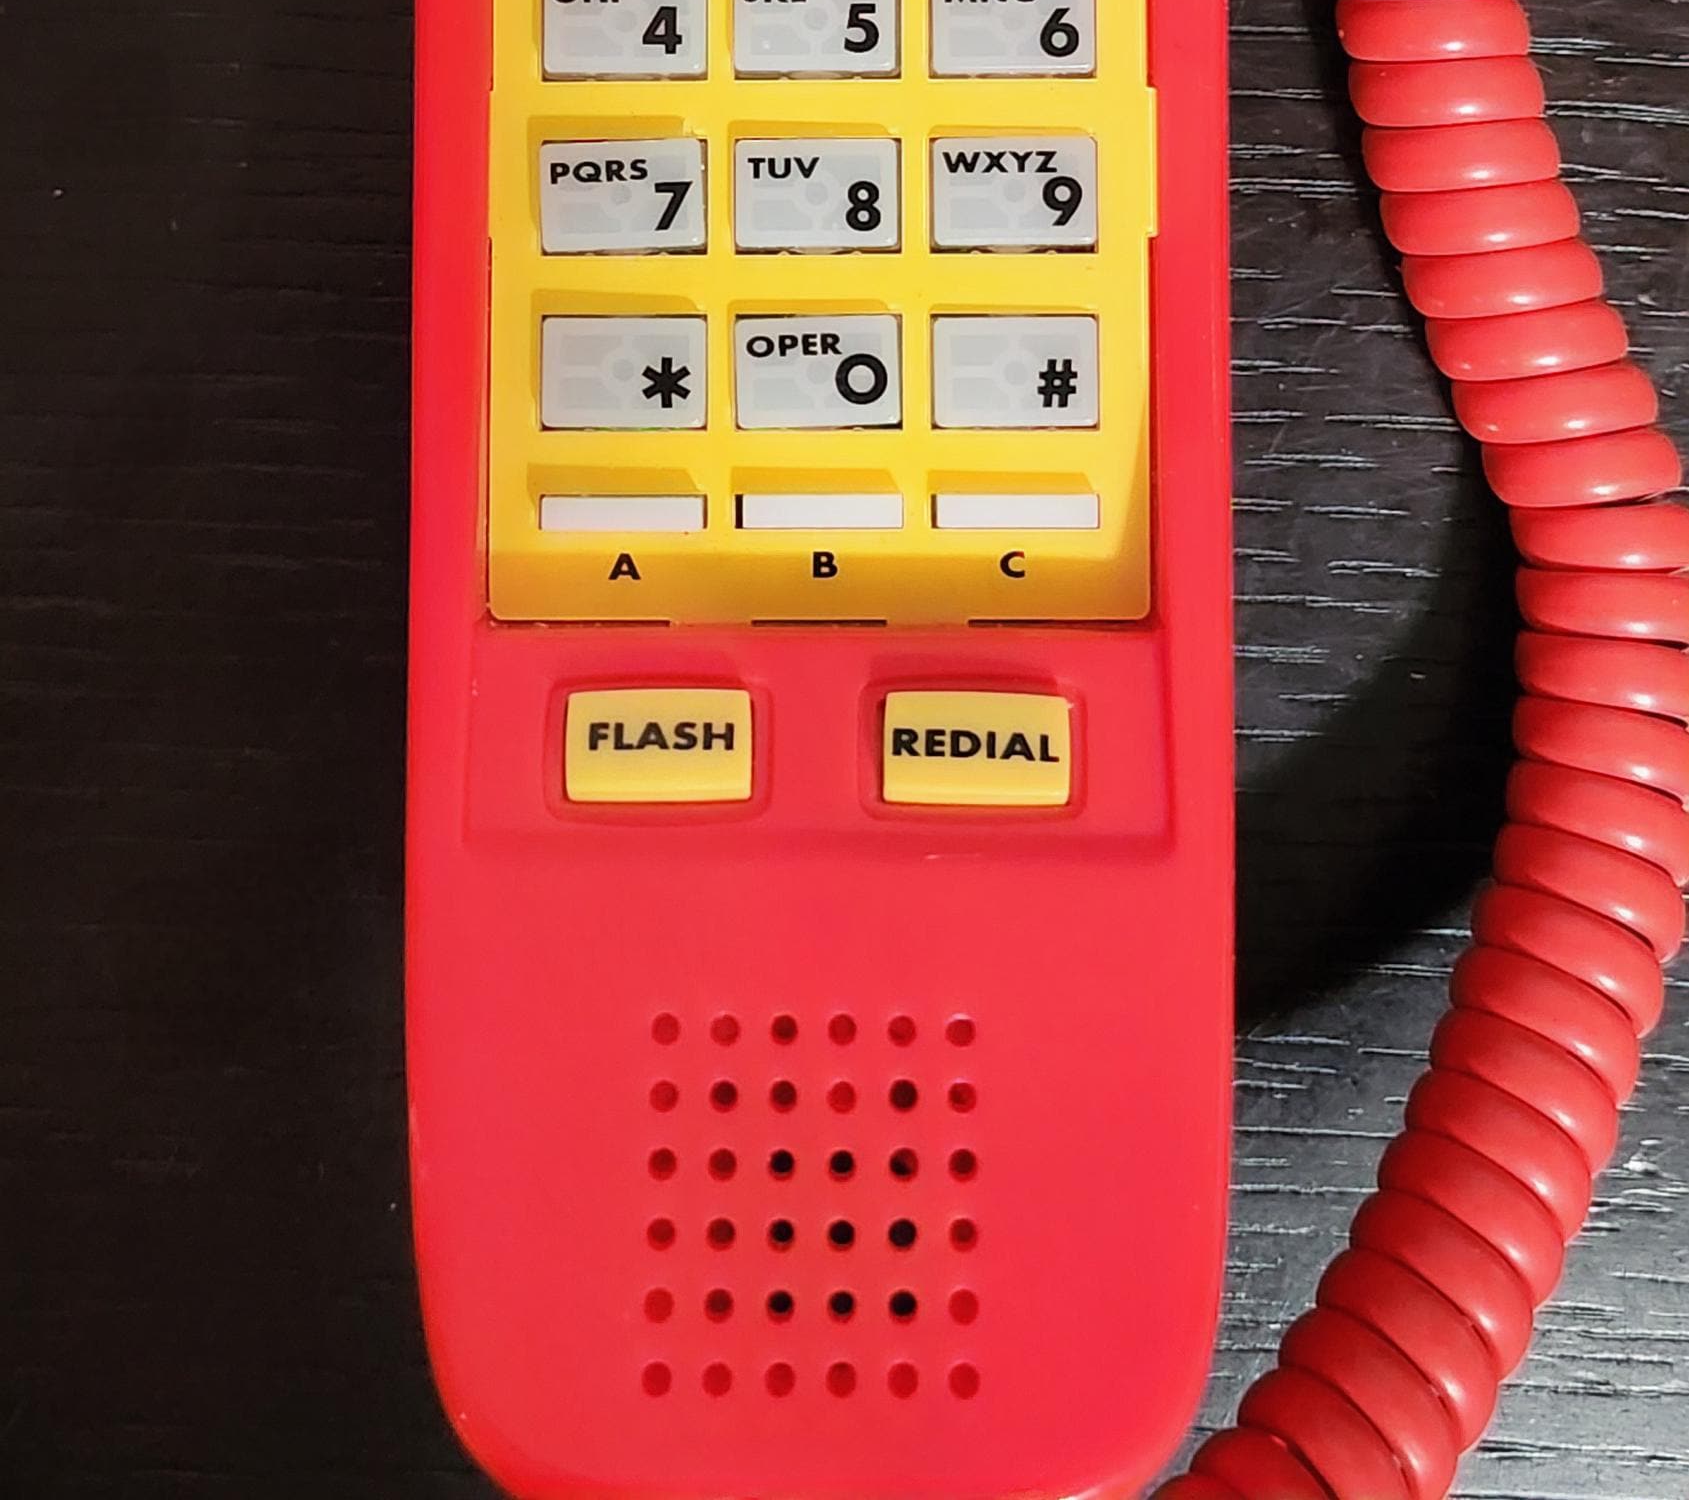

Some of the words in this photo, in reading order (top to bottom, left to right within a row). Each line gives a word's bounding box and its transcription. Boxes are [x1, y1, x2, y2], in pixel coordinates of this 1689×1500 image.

[642, 5, 683, 55] 4
[843, 2, 880, 54] 5
[1039, 7, 1080, 58] 6
[550, 158, 648, 185] PQRS
[747, 156, 820, 180] TUV
[942, 150, 1058, 174] WXYZ
[654, 180, 693, 232] 7
[845, 180, 882, 232] 8
[1042, 175, 1083, 227] 9
[746, 332, 843, 358] OPER
[1037, 358, 1078, 409] #
[609, 553, 641, 581] A
[812, 551, 838, 579] B
[999, 551, 1025, 579] C
[588, 722, 735, 751] FLASH
[892, 727, 1059, 763] REDIAL
